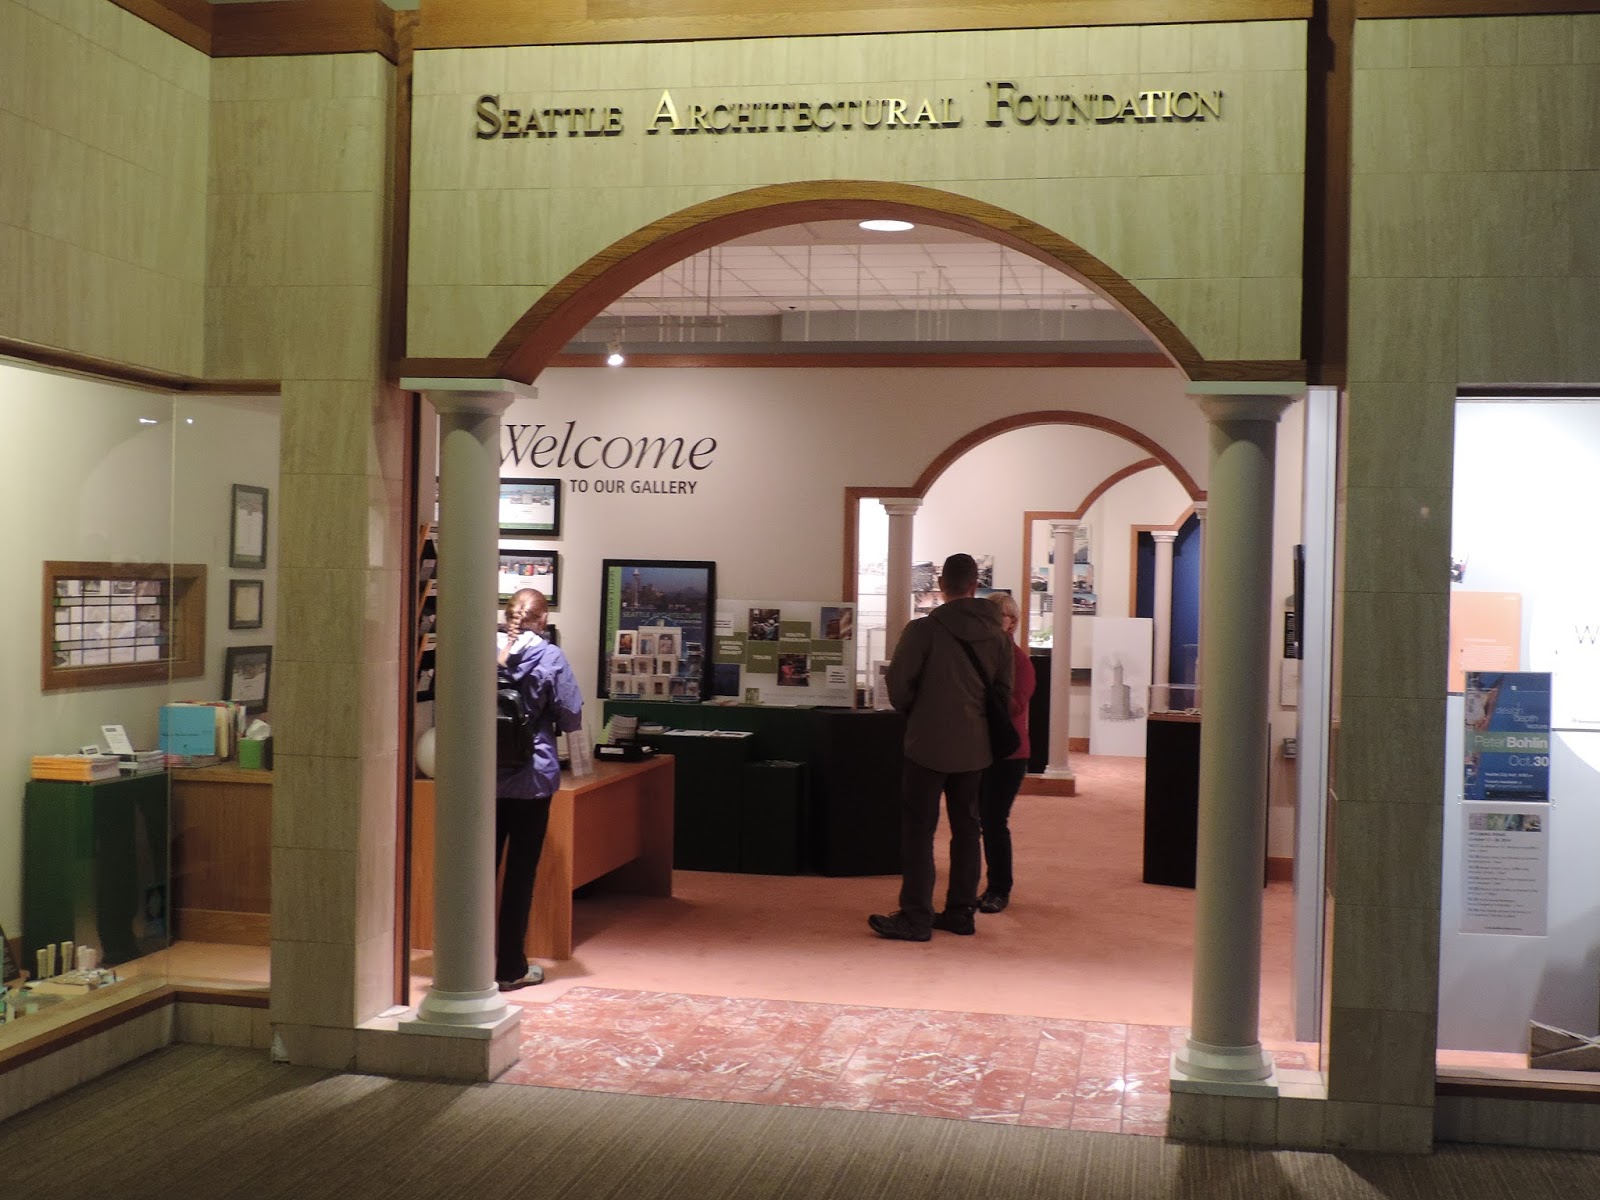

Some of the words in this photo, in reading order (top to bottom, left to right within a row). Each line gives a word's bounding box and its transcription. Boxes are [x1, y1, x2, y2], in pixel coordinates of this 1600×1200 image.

[475, 94, 623, 138] SEATTLE
[646, 89, 962, 137] ARCHITECTURAL
[985, 81, 1223, 128] FOUNDATION
[500, 420, 717, 470] Welcome
[570, 479, 588, 493] TO
[594, 480, 625, 494] OUR
[631, 480, 697, 495] GALLERY
[1506, 736, 1548, 749] Bohlin
